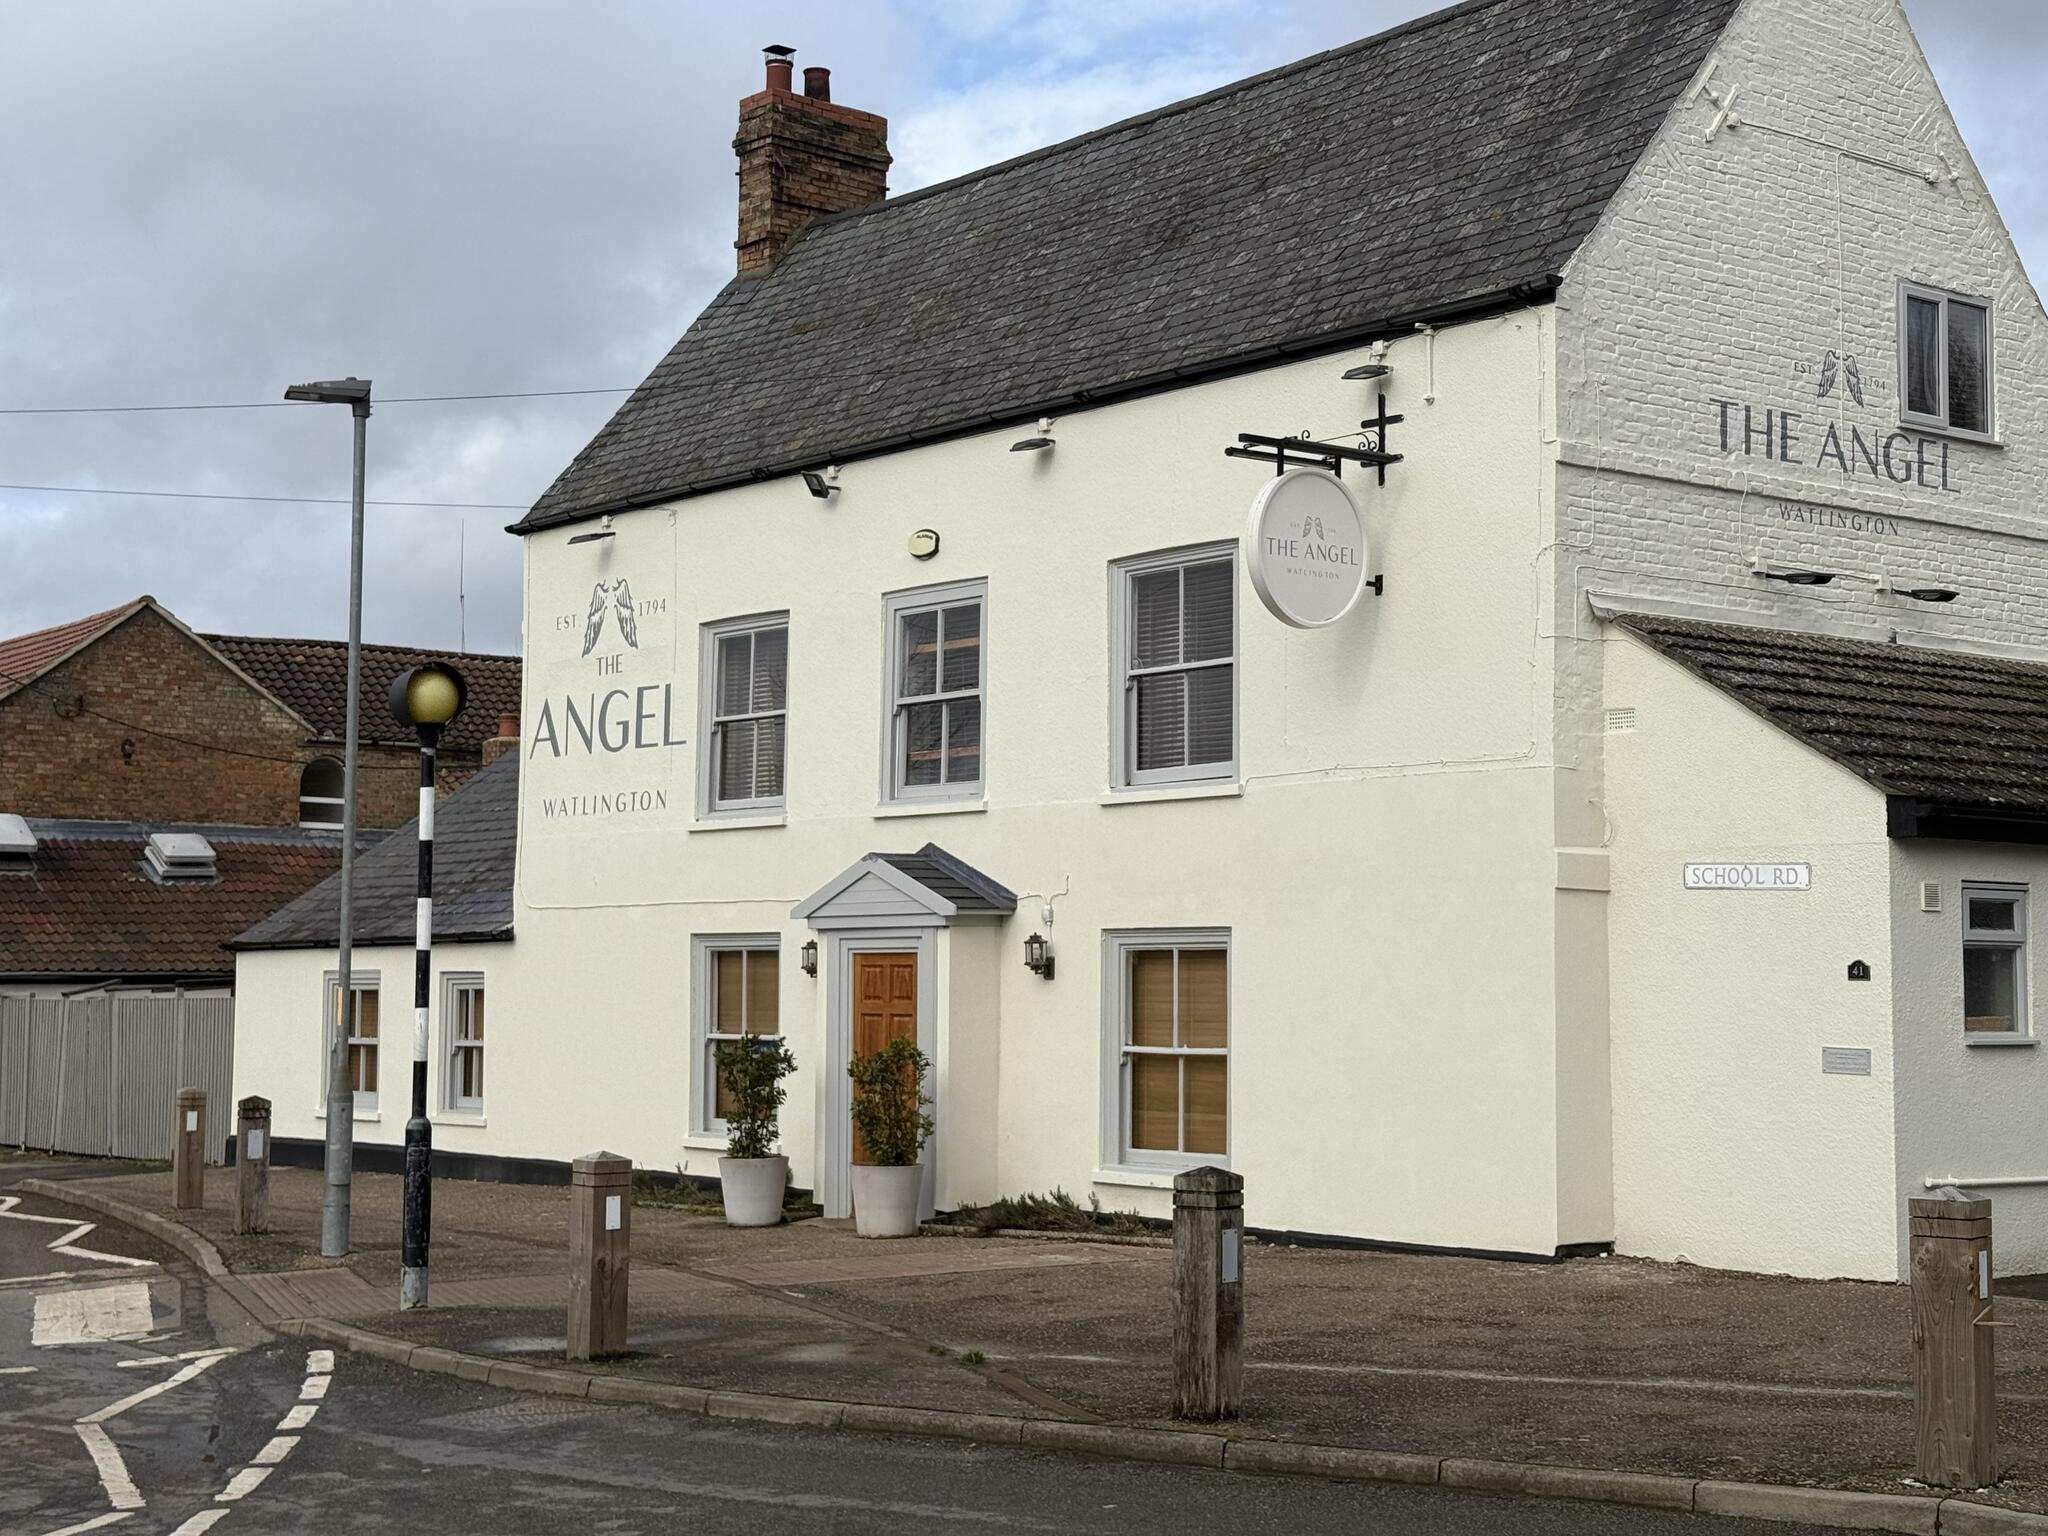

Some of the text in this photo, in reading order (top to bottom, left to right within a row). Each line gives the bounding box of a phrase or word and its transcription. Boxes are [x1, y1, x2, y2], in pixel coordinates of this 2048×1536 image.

[1709, 397, 1961, 493] THE ANGEL
[1779, 503, 1899, 537] WATLINGTON
[1266, 536, 1359, 566] THE ANGEL
[639, 598, 666, 617] 1794
[596, 654, 623, 677] THE
[530, 683, 687, 760] ANGEL
[543, 789, 668, 818] WATLINGTON
[1692, 866, 1765, 885] SCHOOL
[1852, 966, 1864, 976] 41
